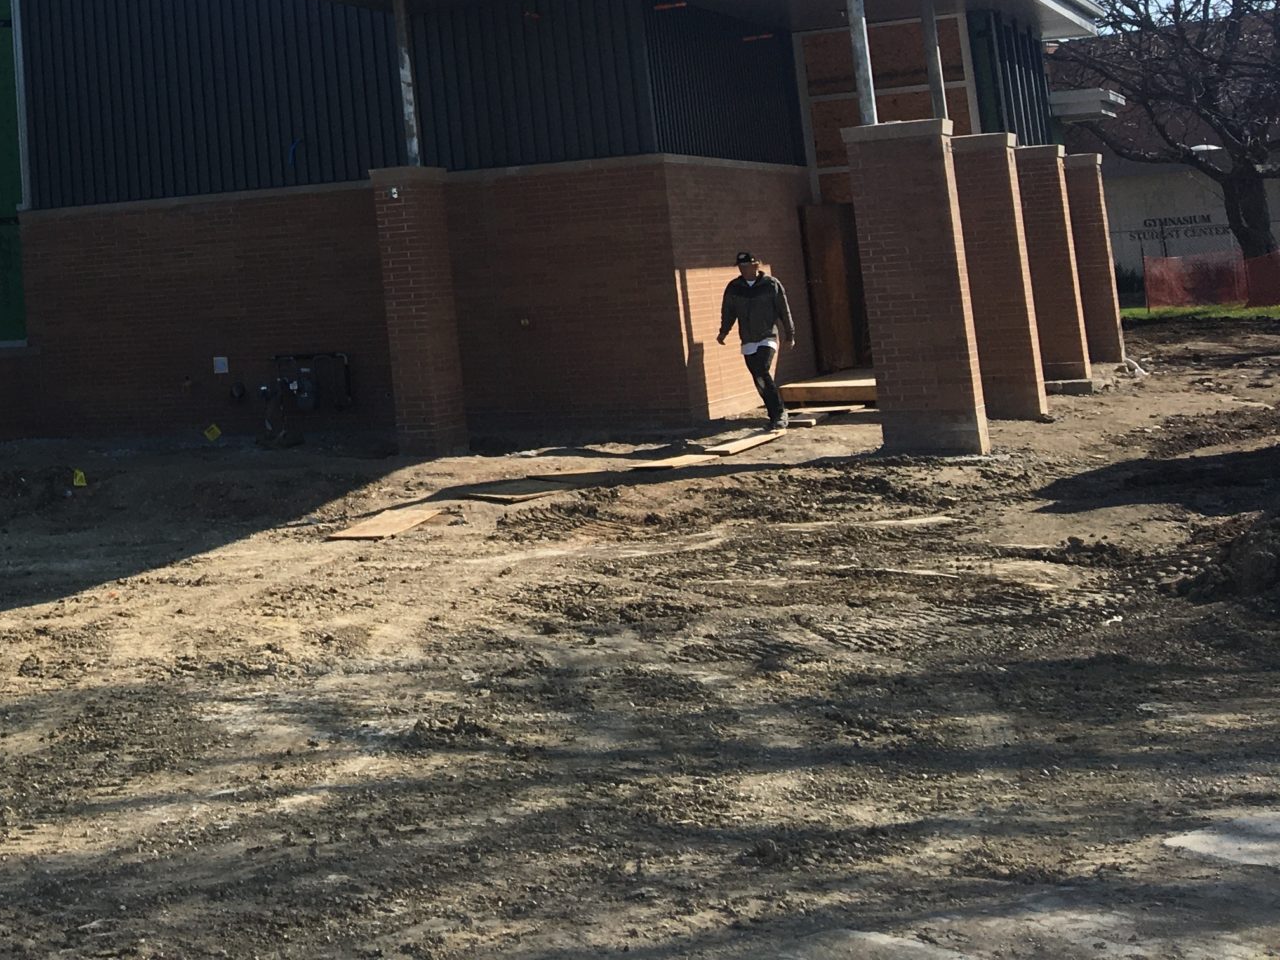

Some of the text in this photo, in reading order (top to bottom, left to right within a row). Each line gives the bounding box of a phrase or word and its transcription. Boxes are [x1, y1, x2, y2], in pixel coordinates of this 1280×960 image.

[1143, 214, 1211, 228] GYMNASIUM
[1129, 226, 1231, 241] STUDNT CENTER
